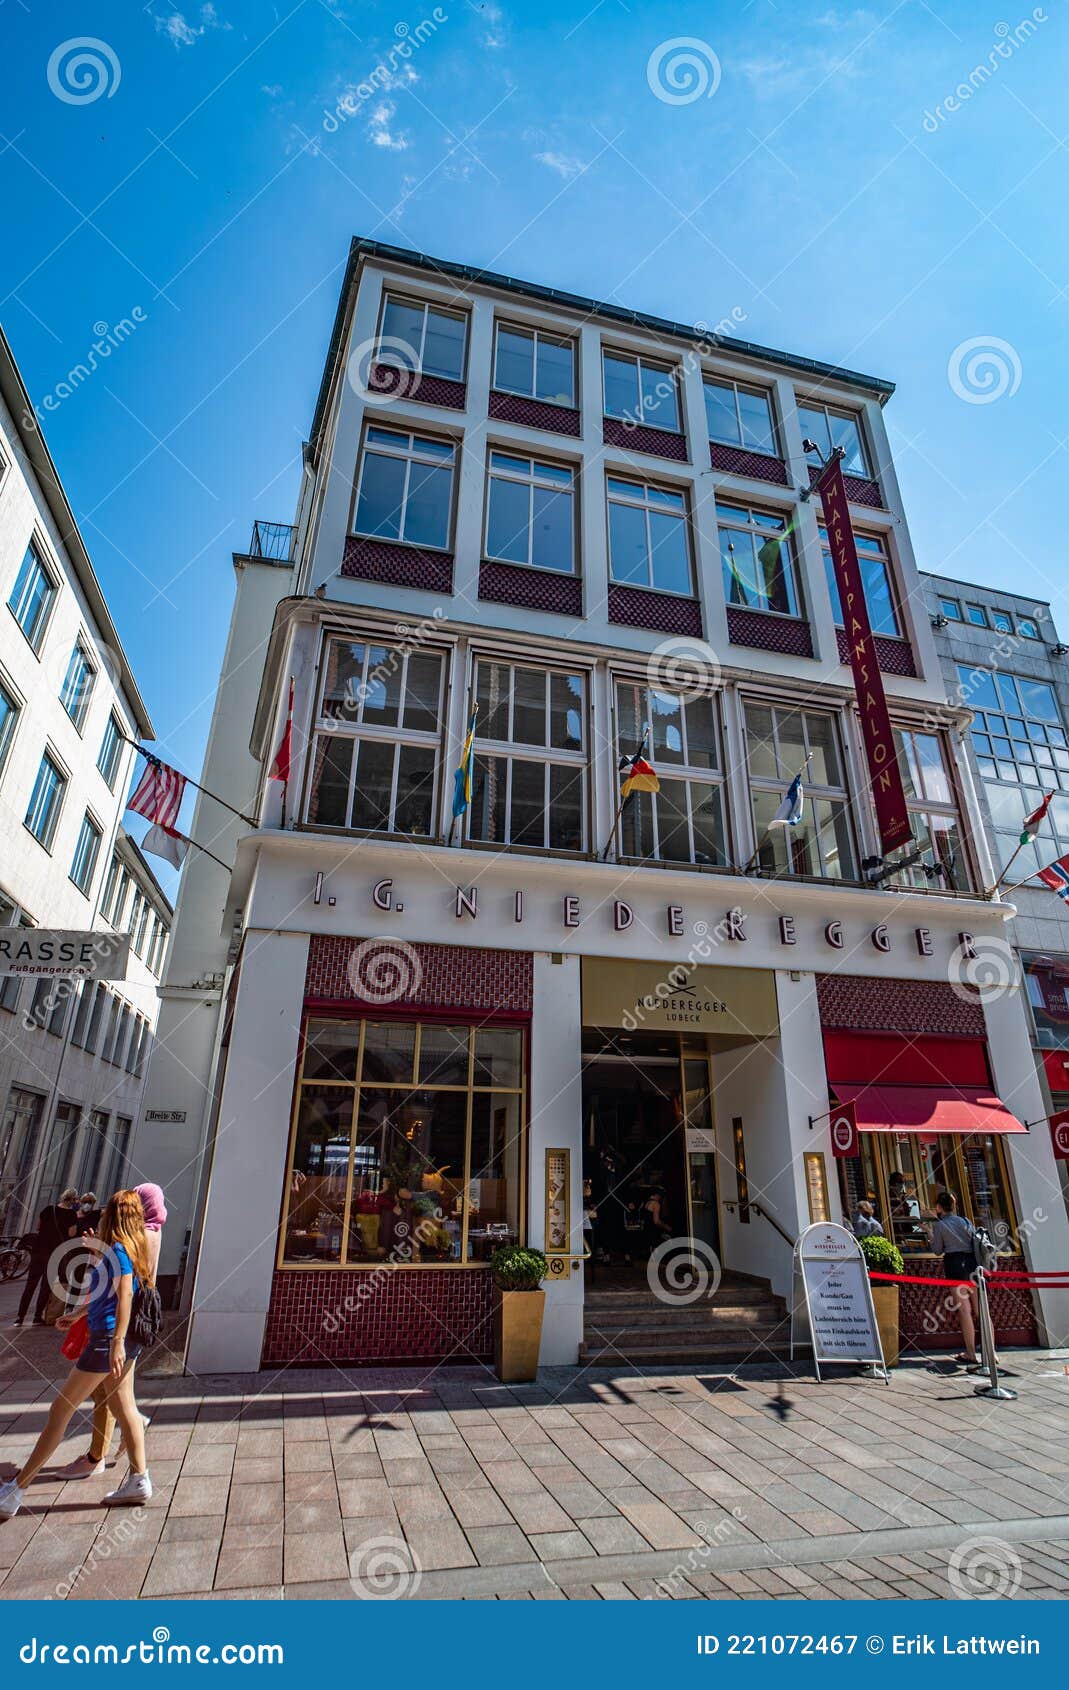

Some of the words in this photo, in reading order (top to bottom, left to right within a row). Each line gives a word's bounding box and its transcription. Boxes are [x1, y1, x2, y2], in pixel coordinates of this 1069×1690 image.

[826, 483, 890, 793] MARZIPANSALON
[314, 872, 336, 906] I.
[373, 879, 404, 912] G.
[455, 887, 979, 960] NIEDEREGGER
[0, 940, 94, 962] RASSE
[637, 999, 728, 1012] NIEDEREGGER
